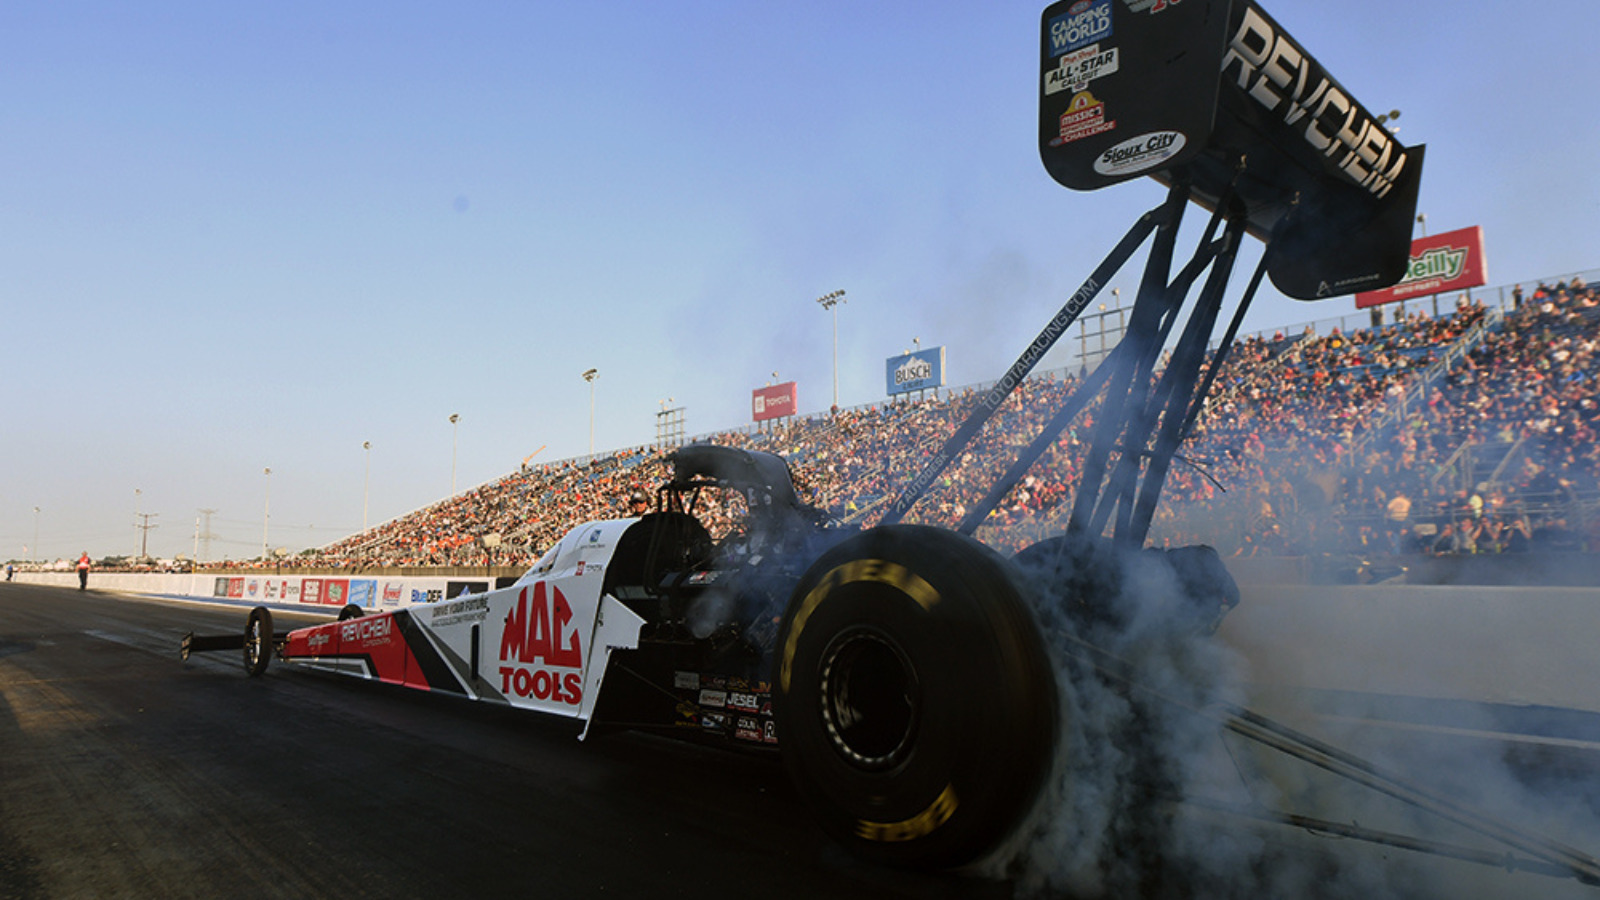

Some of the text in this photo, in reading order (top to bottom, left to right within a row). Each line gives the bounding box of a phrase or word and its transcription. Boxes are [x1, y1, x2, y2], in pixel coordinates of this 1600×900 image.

[1051, 3, 1110, 36] CAMPING
[1052, 16, 1110, 48] WORLD
[1061, 70, 1098, 88] CALLOUT
[1221, 7, 1407, 199] REVCHEM
[1064, 121, 1114, 142] CHALLENGE
[1102, 143, 1142, 163] Sioux
[1147, 132, 1178, 150] City
[982, 278, 1099, 410] TOYOTARACING.COM
[895, 363, 932, 385] BUSCH
[766, 394, 791, 407] TOYOTA
[905, 450, 949, 502] AUTODESK
[342, 617, 392, 642] REVCHEM
[499, 580, 582, 668] MAC
[499, 666, 582, 706] TOOLS
[727, 692, 759, 709] JESEL
